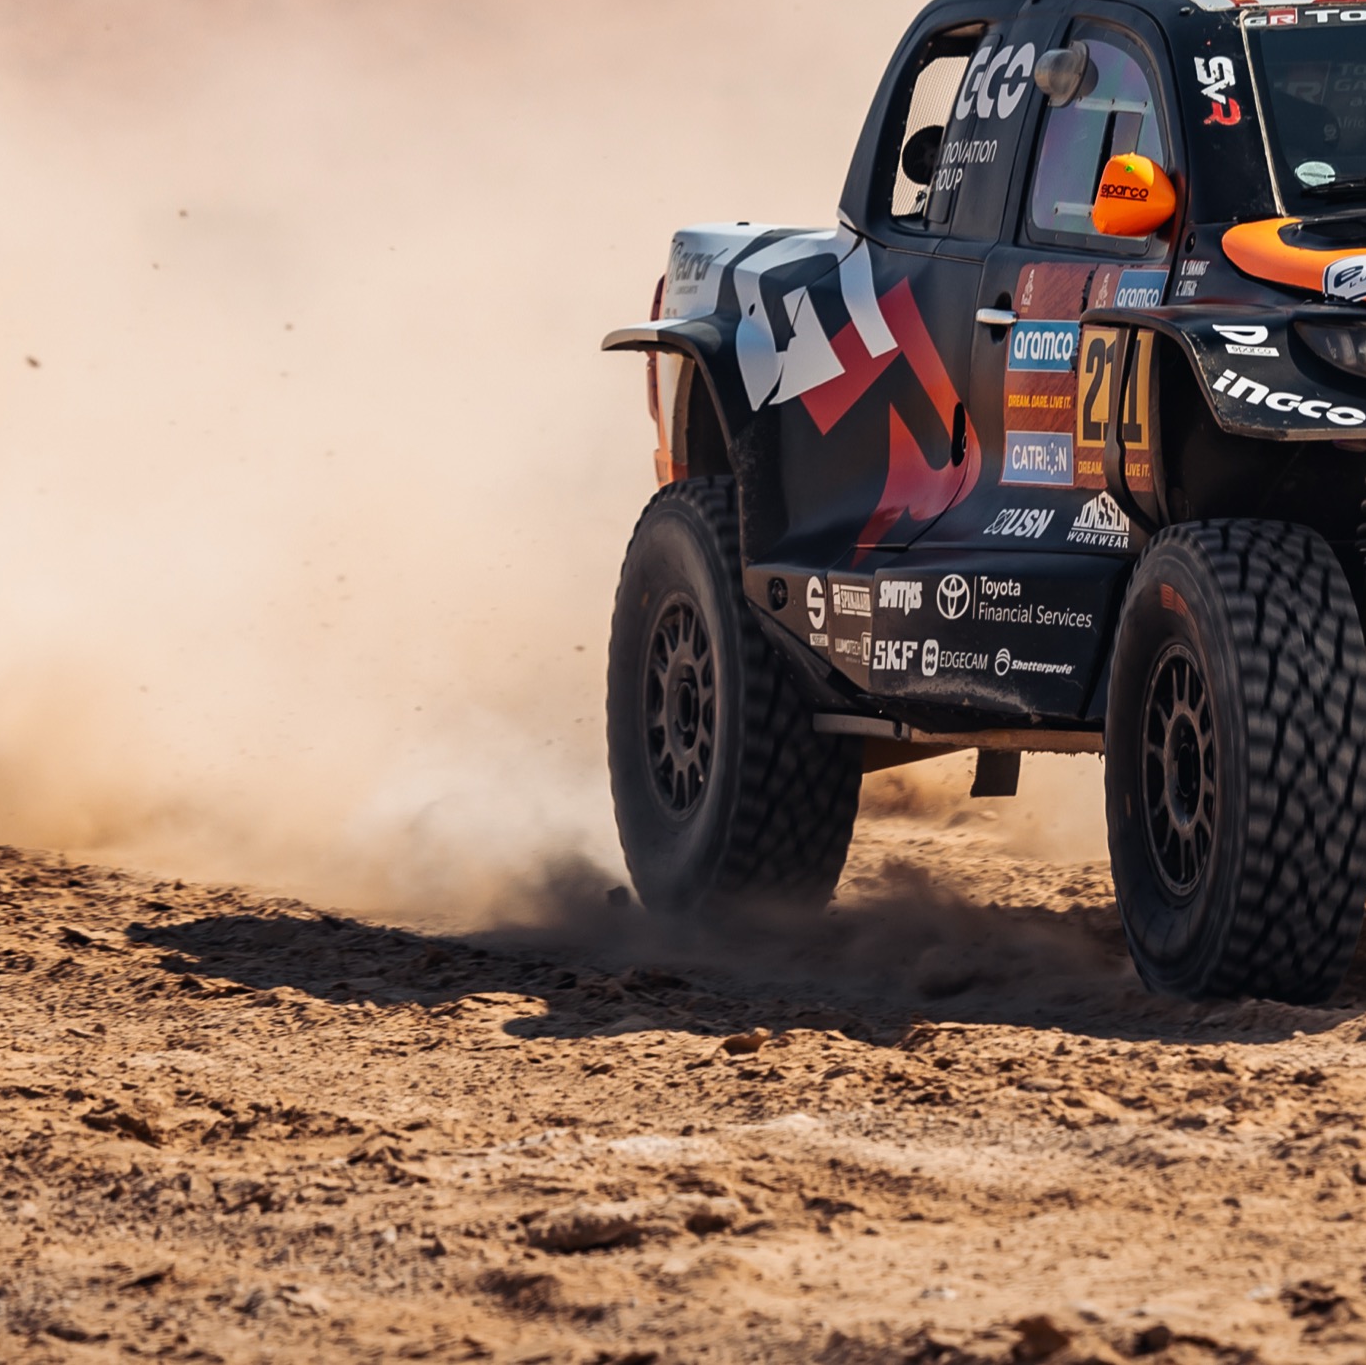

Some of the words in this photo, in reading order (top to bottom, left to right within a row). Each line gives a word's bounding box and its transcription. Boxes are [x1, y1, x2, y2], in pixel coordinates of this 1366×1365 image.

[1100, 183, 1149, 201] sparco
[1116, 287, 1160, 307] aramco
[1013, 330, 1073, 362] aramco
[1230, 345, 1272, 355] sparco
[1073, 490, 1130, 532] JONSSON
[1001, 508, 1055, 539] USN
[1066, 530, 1129, 549] WORKWEAR
[980, 576, 1021, 597] Toyota
[978, 602, 1033, 623] Financial
[1036, 605, 1093, 628] Services
[872, 640, 919, 670] SKF
[939, 650, 989, 671] EDGECAM
